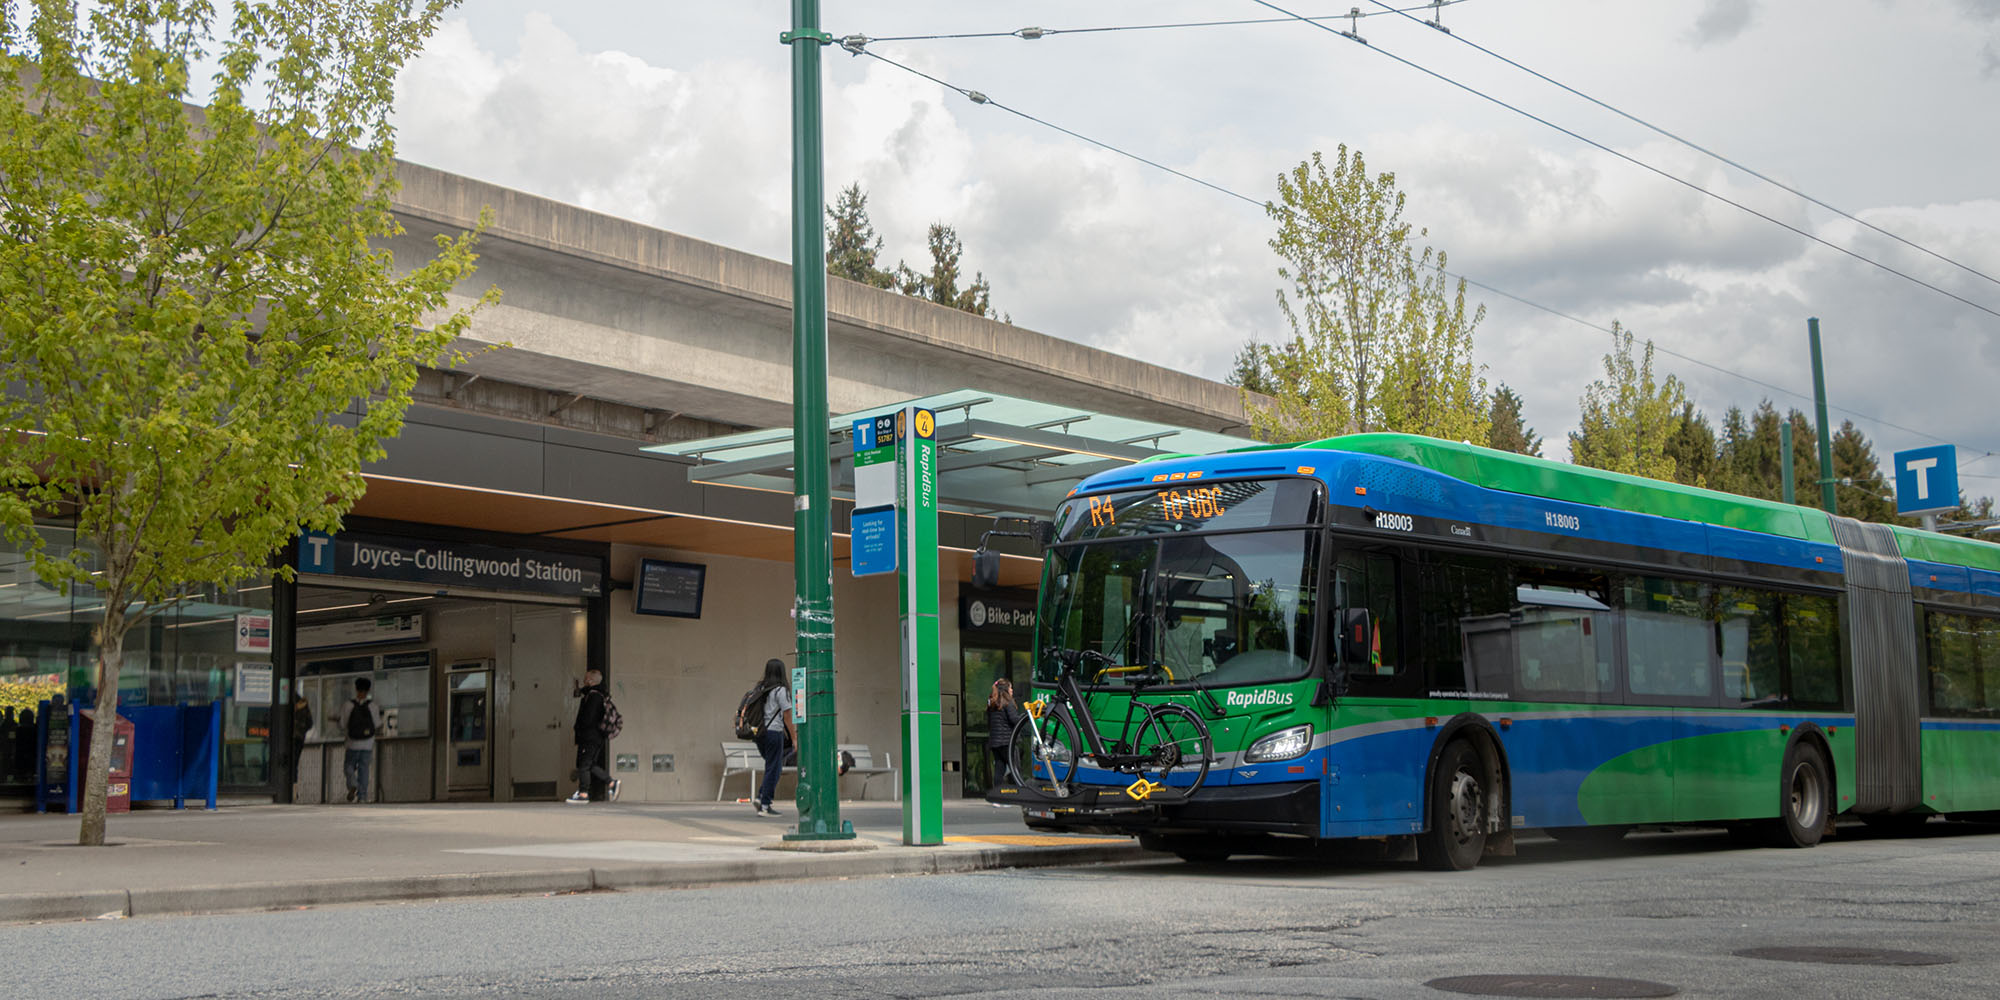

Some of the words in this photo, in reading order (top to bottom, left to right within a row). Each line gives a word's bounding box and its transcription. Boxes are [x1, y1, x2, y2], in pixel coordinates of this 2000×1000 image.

[858, 423, 870, 445] T
[921, 421, 929, 434] 4
[919, 444, 932, 508] RapidBus
[1906, 457, 1938, 500] T
[1088, 495, 1116, 527] R4
[1157, 491, 1184, 521] TO
[1186, 487, 1225, 519] UBC
[1376, 512, 1413, 532] H18003
[1545, 511, 1580, 531] H18003
[308, 537, 328, 566] T
[526, 559, 582, 583] Station
[988, 607, 1011, 625] Bike
[1226, 689, 1294, 709] RapidBus
